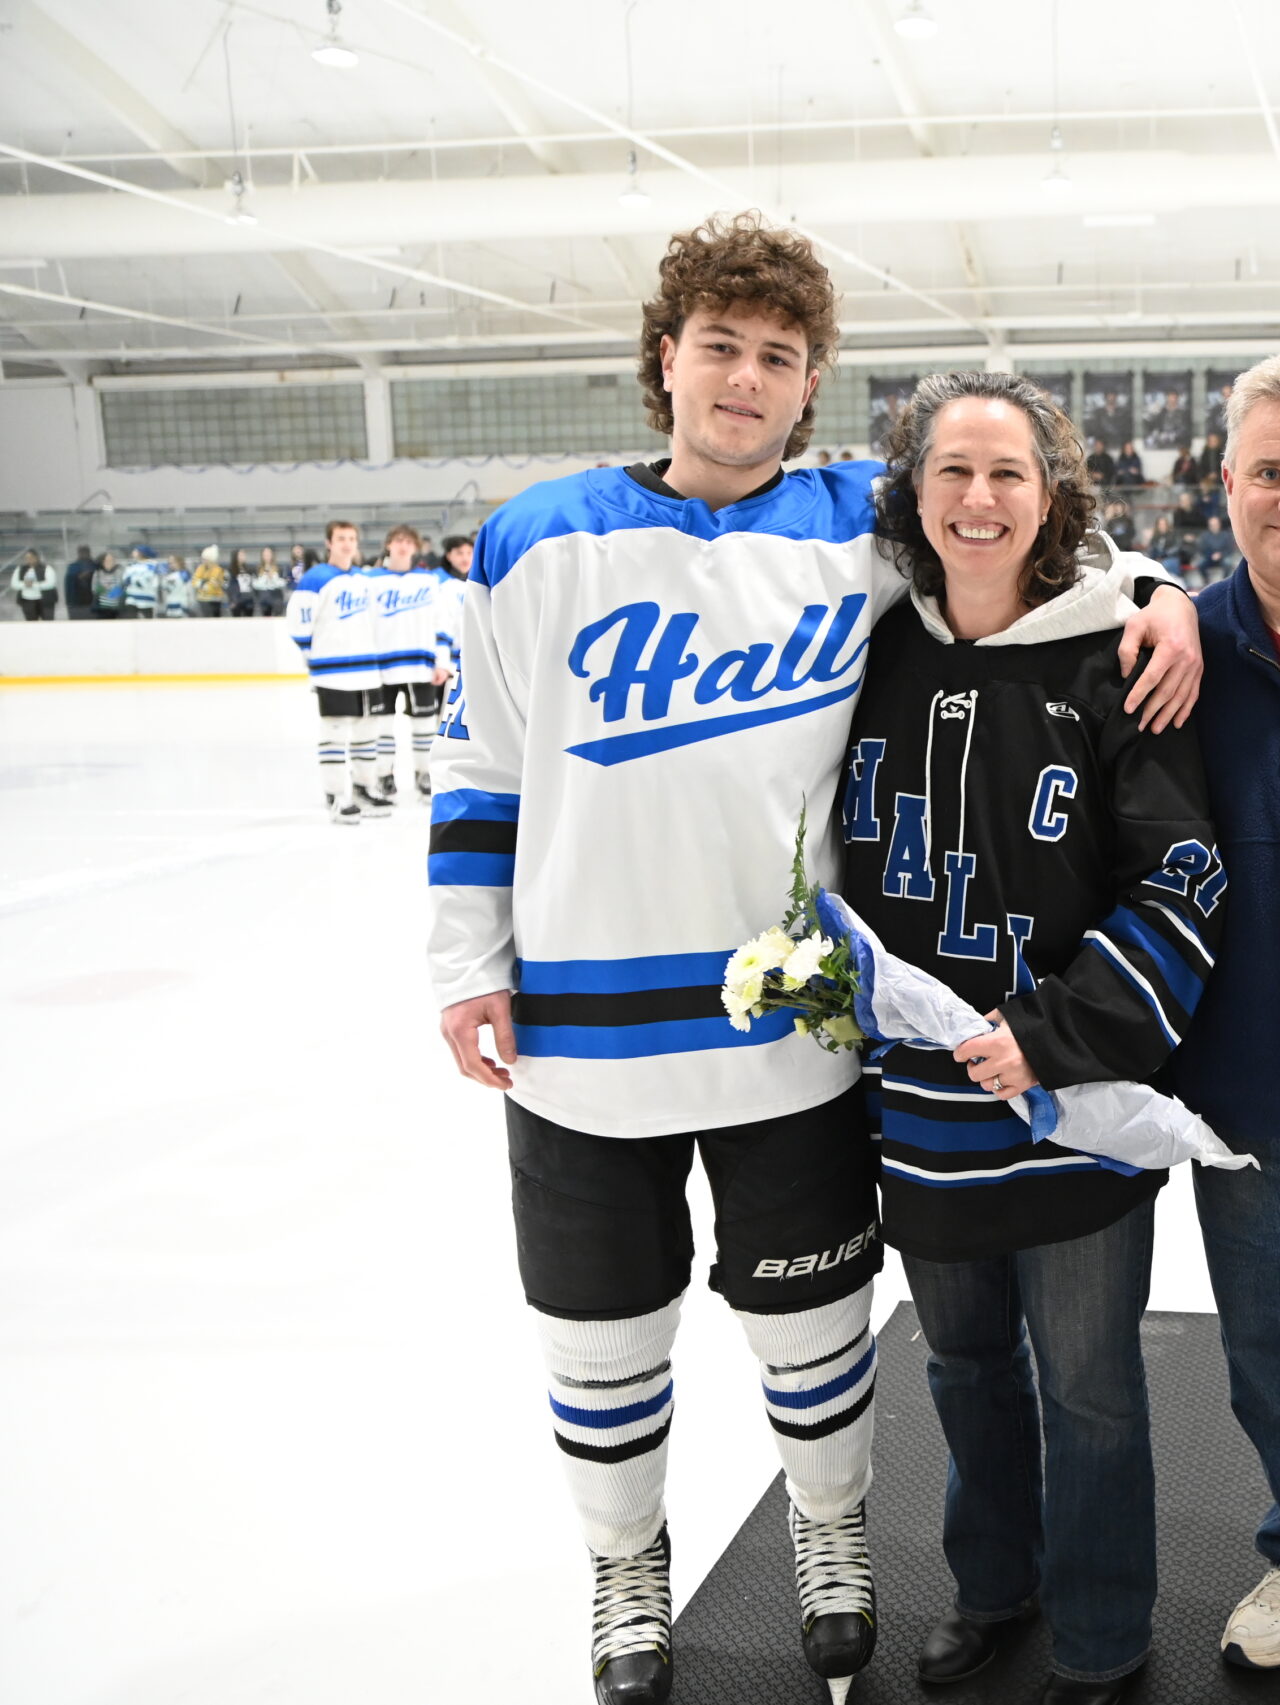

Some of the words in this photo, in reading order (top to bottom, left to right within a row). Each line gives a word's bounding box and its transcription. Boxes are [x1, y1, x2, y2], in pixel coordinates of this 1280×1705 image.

[567, 592, 872, 723] Hall
[1028, 764, 1078, 842] C
[1140, 838, 1228, 918] 21
